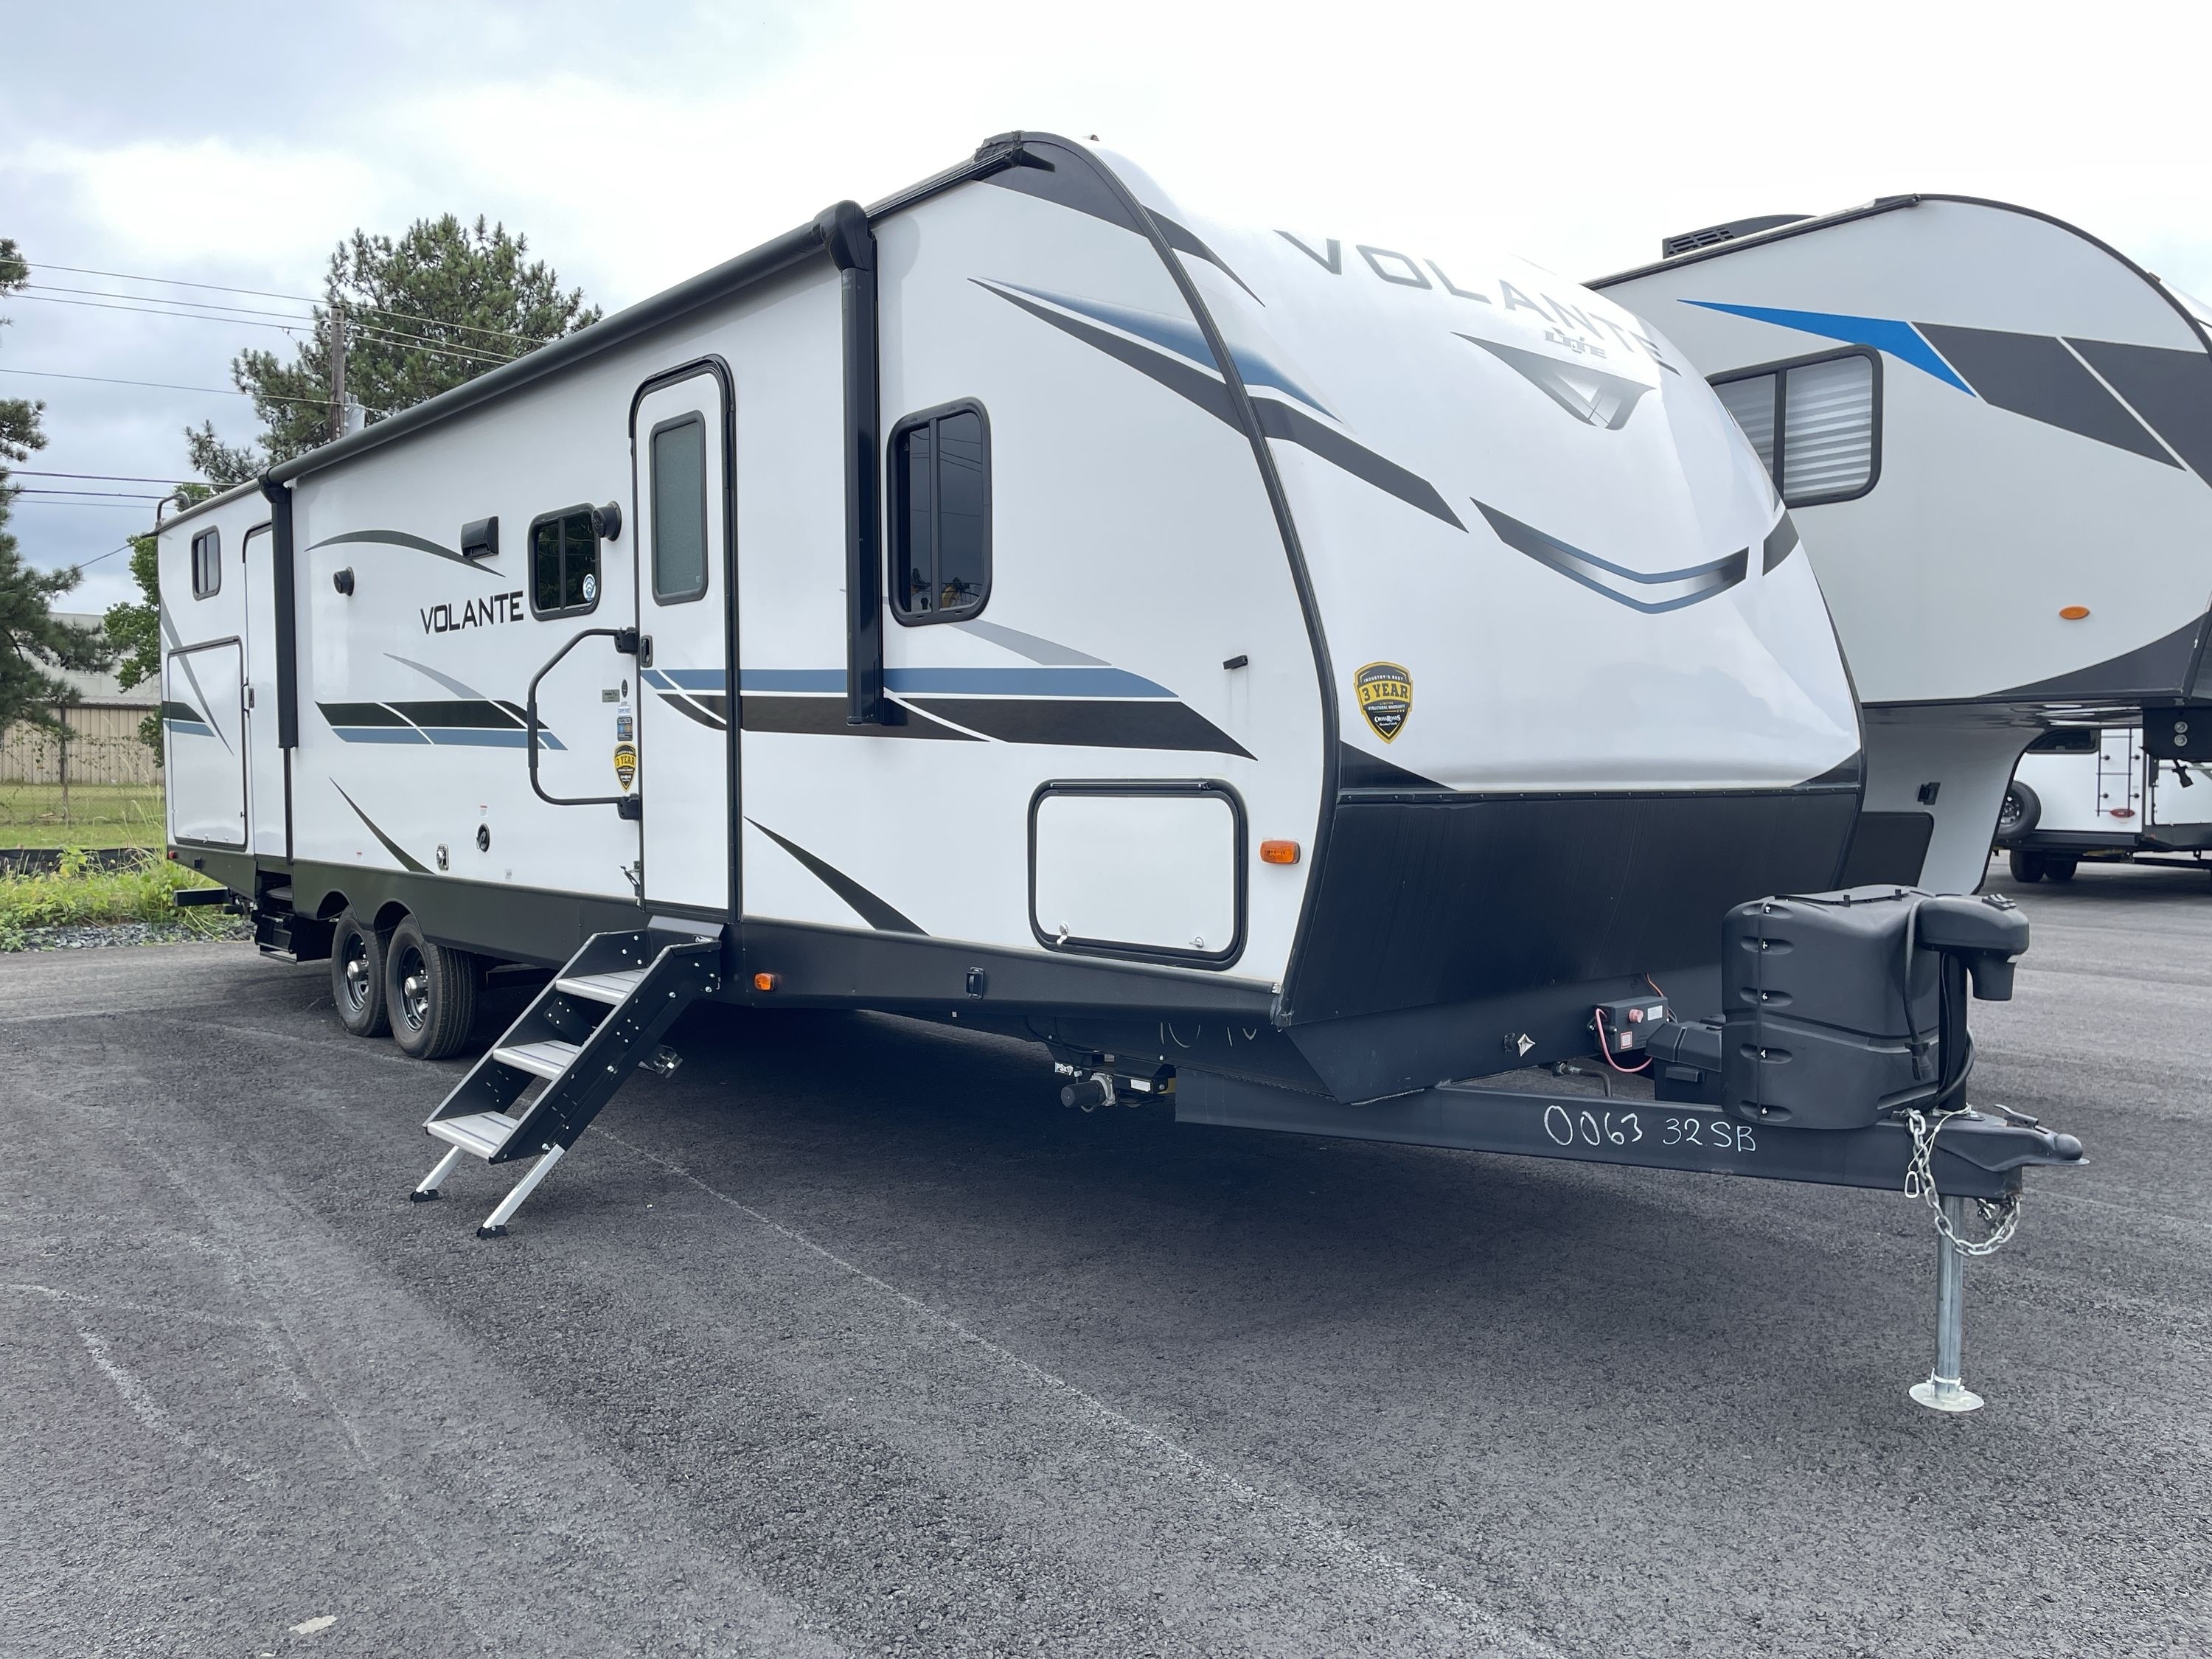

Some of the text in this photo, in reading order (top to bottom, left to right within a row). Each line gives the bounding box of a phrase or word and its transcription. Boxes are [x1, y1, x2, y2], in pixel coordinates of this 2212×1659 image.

[1273, 229, 1682, 378] VOLANTE
[420, 591, 524, 635] VOLANTE
[1362, 683, 1408, 702] 3 YEAR
[620, 756, 634, 765] YEAR
[1544, 1105, 1756, 1152] 0063 32SB
